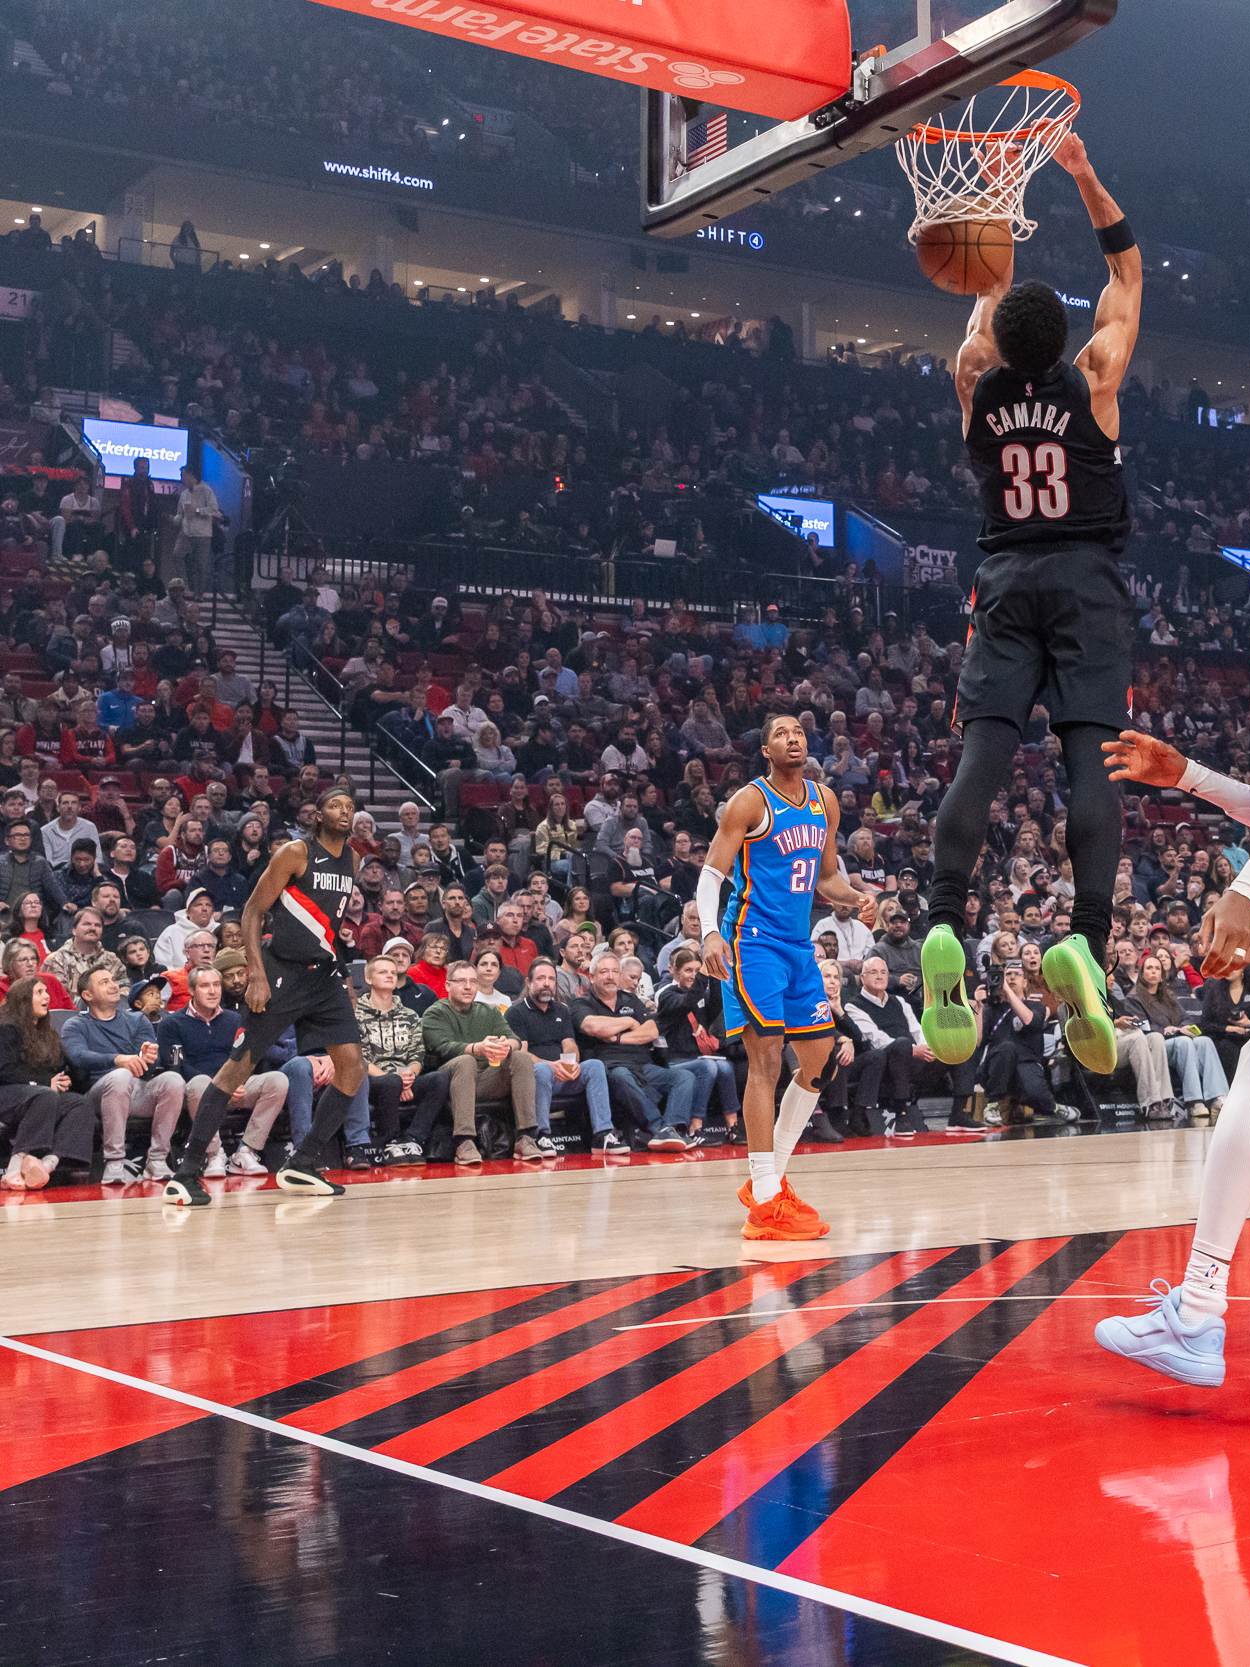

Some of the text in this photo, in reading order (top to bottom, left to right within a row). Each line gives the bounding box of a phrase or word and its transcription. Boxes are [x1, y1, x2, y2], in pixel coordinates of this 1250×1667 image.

[323, 161, 434, 190] www.shift4.com
[985, 402, 1072, 437] CAMARA
[1001, 442, 1070, 520] 33
[916, 544, 958, 567] CITY
[790, 858, 818, 893] 21
[336, 895, 348, 919] 9
[551, 1135, 581, 1144] UNTAIN
